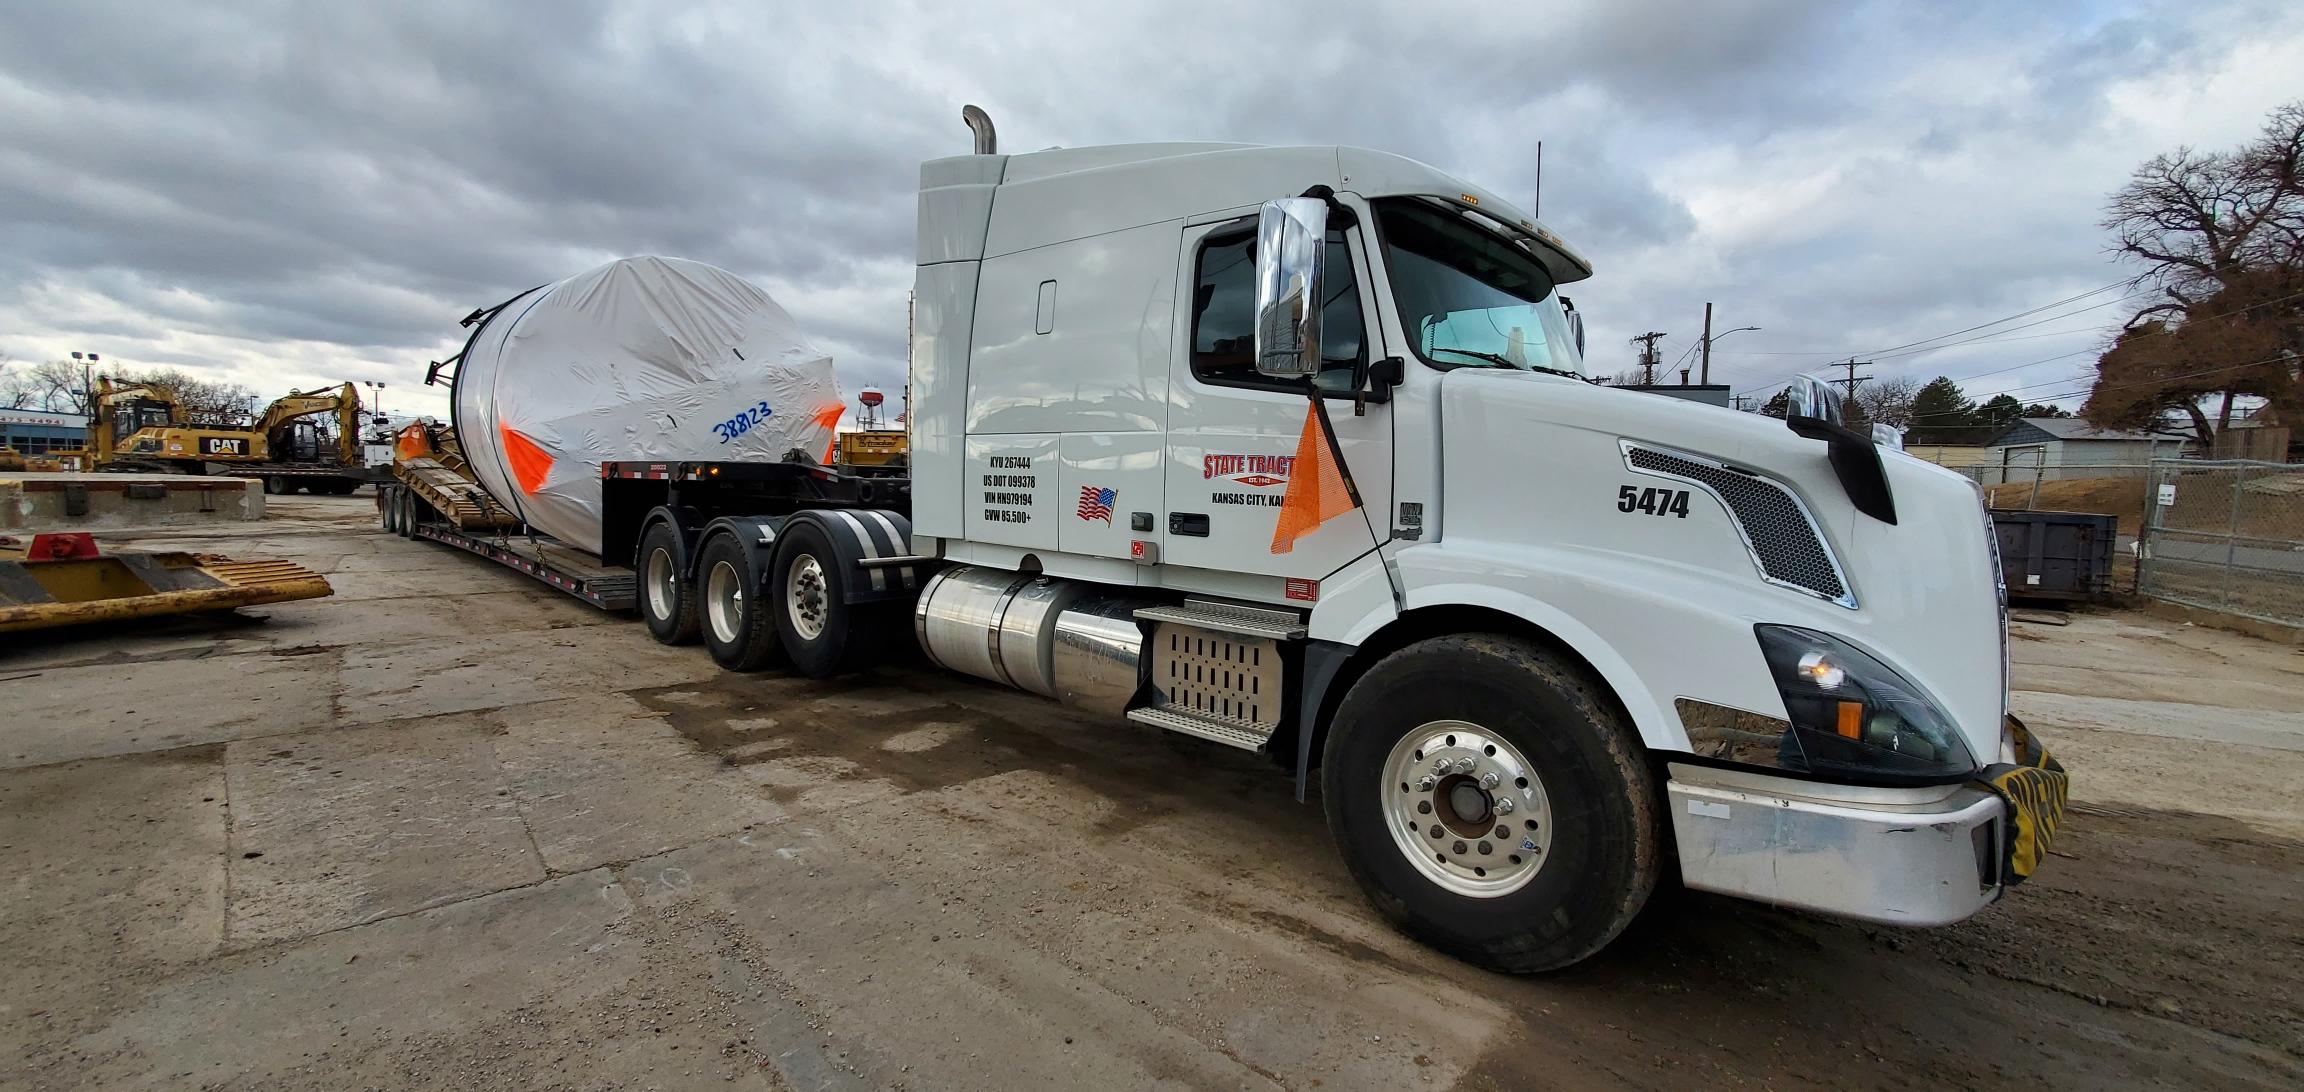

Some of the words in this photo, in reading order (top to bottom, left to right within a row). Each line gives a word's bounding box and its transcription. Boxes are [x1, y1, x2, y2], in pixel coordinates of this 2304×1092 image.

[712, 401, 772, 444] 388123
[210, 438, 241, 454] CAT
[990, 456, 1003, 468] KYU
[1004, 456, 1031, 469] 267444
[1203, 454, 1245, 479] STATE
[983, 474, 992, 487] US
[993, 475, 1007, 487] DOT
[1008, 475, 1036, 488] 099378
[984, 491, 996, 504] VIN
[997, 492, 1033, 506] HN979194
[1212, 492, 1245, 505] KANSAS
[1246, 494, 1267, 507] CITY,
[1617, 485, 1690, 519] 5474
[984, 509, 1001, 521] GVW
[1001, 510, 1031, 524] 85,500+
